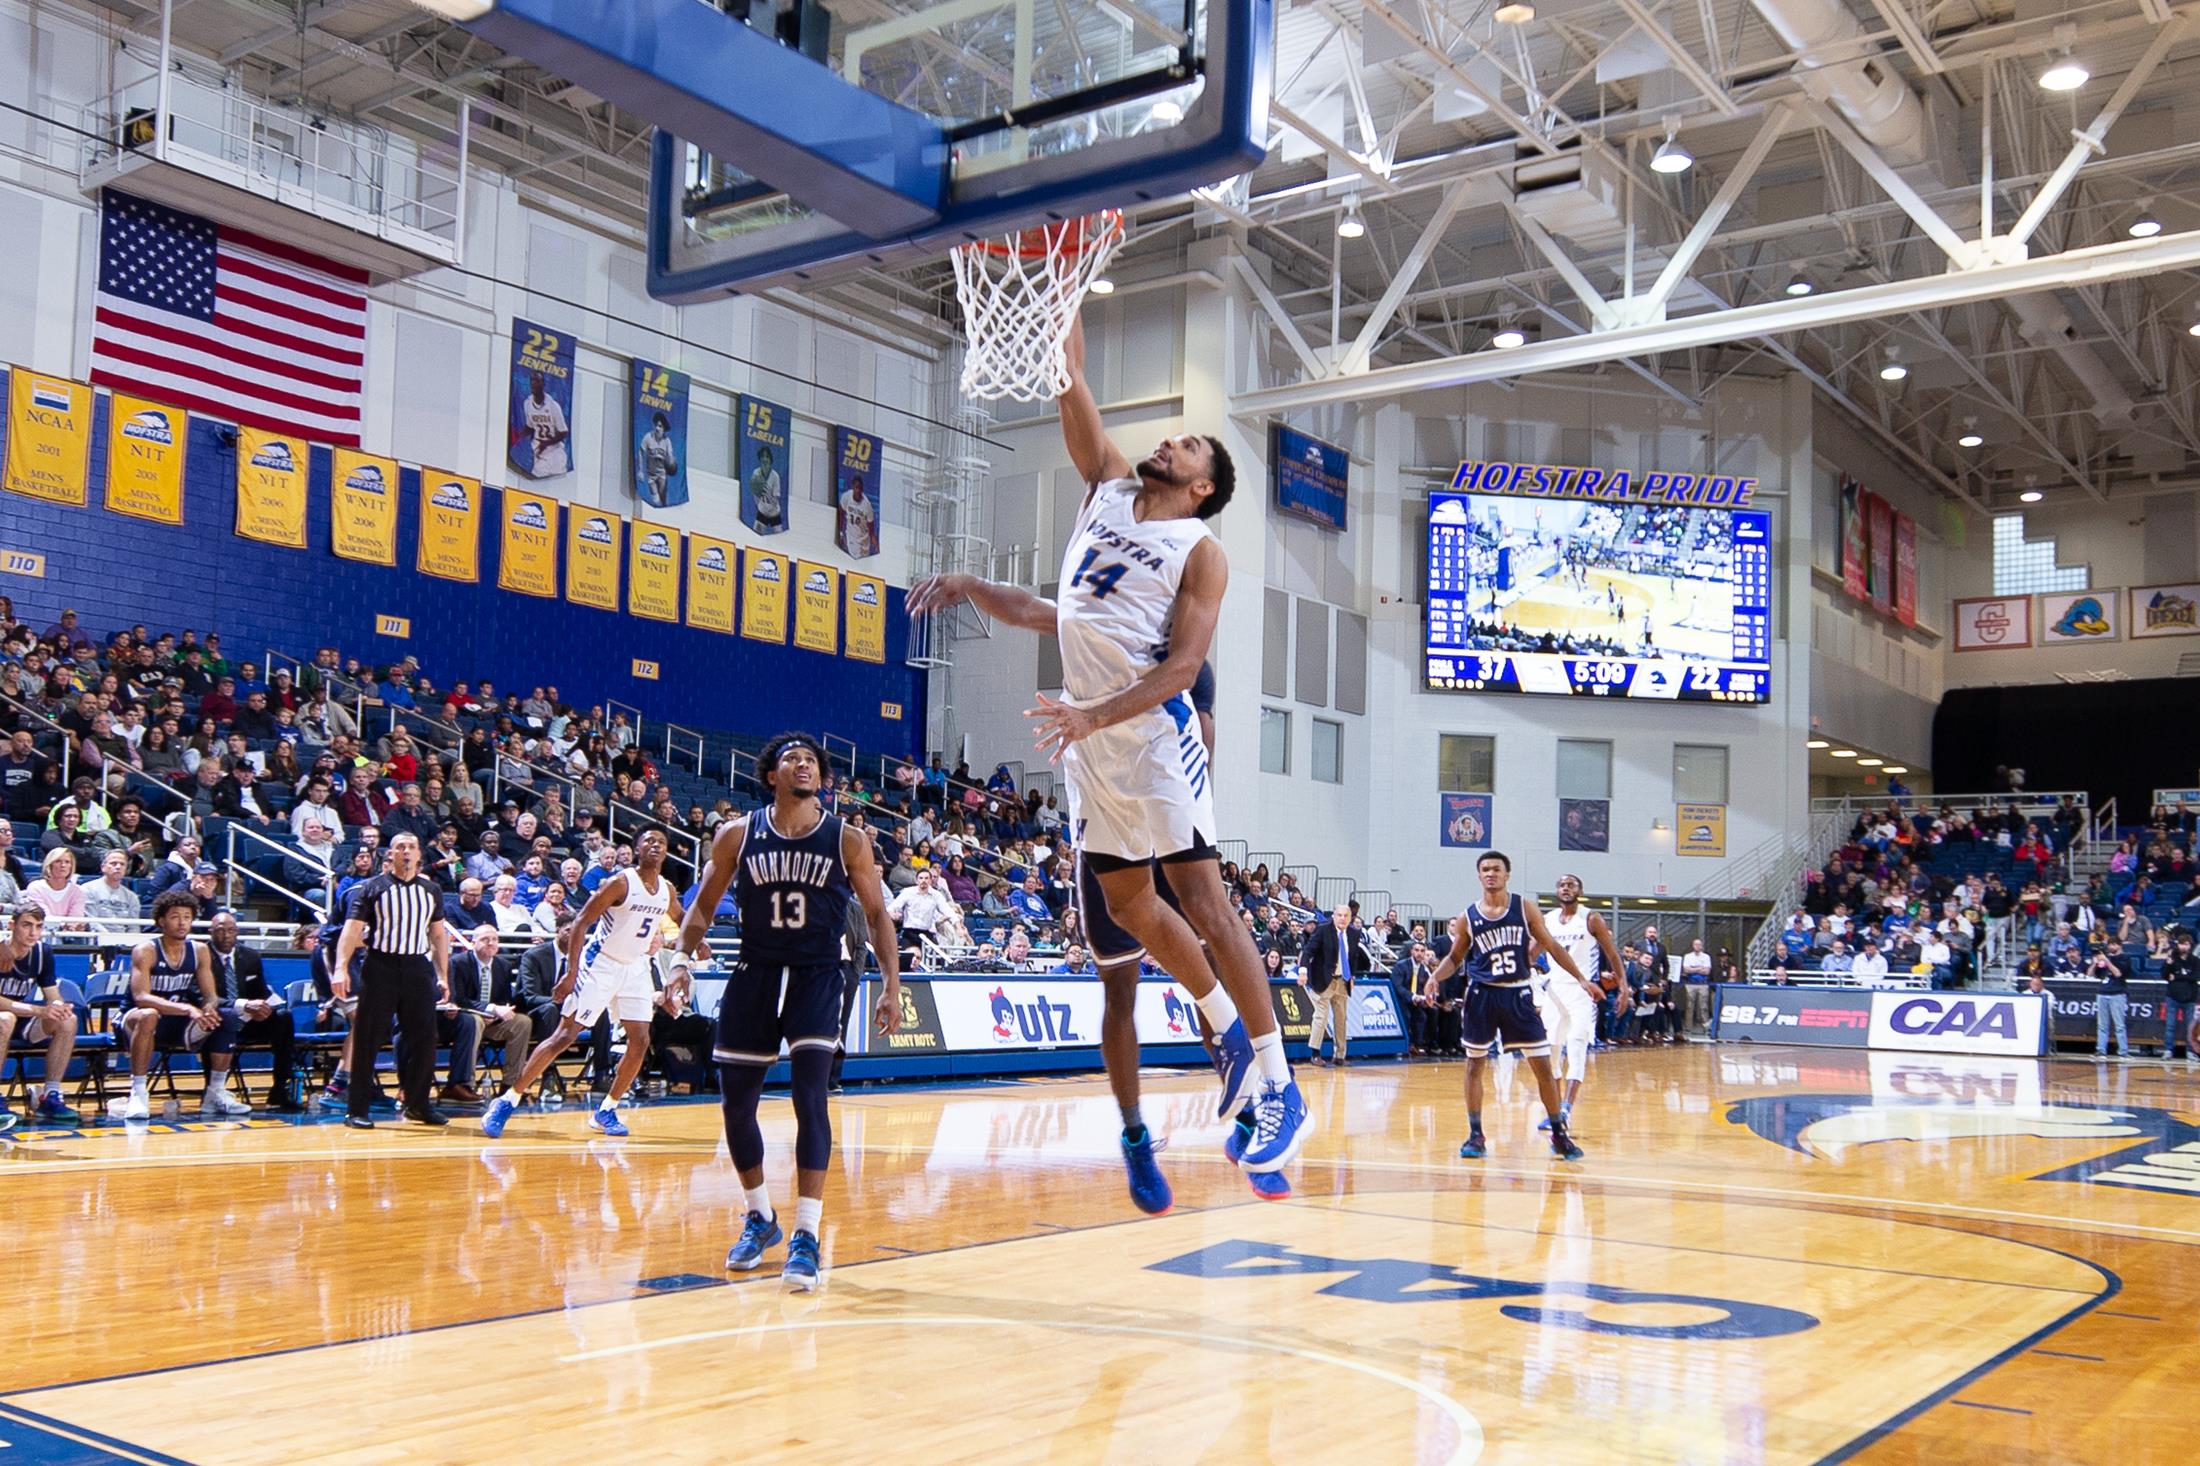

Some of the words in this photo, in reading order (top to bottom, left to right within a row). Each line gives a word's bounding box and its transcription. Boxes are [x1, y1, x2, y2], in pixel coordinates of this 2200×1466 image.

[522, 328, 559, 362] 22
[517, 355, 569, 378] JENKINS
[641, 367, 670, 398] 14
[639, 394, 673, 412] IRWIN
[26, 409, 75, 431] NCAA
[747, 401, 772, 431] 15
[125, 423, 172, 442] HOFSTRA
[36, 443, 61, 457] 2001
[131, 443, 165, 461] NIT
[844, 433, 872, 461] 30
[259, 473, 289, 489] NIT
[1450, 460, 1632, 500] HOFSTRA
[1638, 470, 1760, 507] PRIDE
[437, 513, 464, 529] NIT
[579, 544, 610, 561] WNIT
[1087, 518, 1165, 573] HOFSTRA
[8, 555, 36, 573] 110
[640, 558, 670, 575] WNIT
[1070, 546, 1130, 600] 14
[698, 571, 726, 587] WNIT
[756, 584, 776, 598] NIT
[805, 595, 829, 609] WNIT
[856, 607, 874, 620] NIT
[637, 662, 654, 676] 112
[1477, 655, 1508, 682] 37
[1574, 660, 1627, 685] 5:09
[1690, 664, 1721, 690] 22
[884, 704, 898, 717] 113
[746, 848, 834, 887] MONMOUTH
[770, 892, 807, 929] 13
[635, 917, 653, 938] 5
[1474, 925, 1524, 954] MONMOUTH
[1489, 950, 1517, 977] 25
[105, 974, 130, 995] H
[1720, 1005, 1779, 1025] 98.7
[1799, 1008, 1869, 1029] ESPN
[1889, 998, 2018, 1040] CAA
[2050, 1000, 2153, 1018] FLOSPRTS
[1362, 1013, 1397, 1026] HOFSTRA
[889, 1034, 914, 1048] ARMY
[913, 1033, 936, 1047] ROTC
